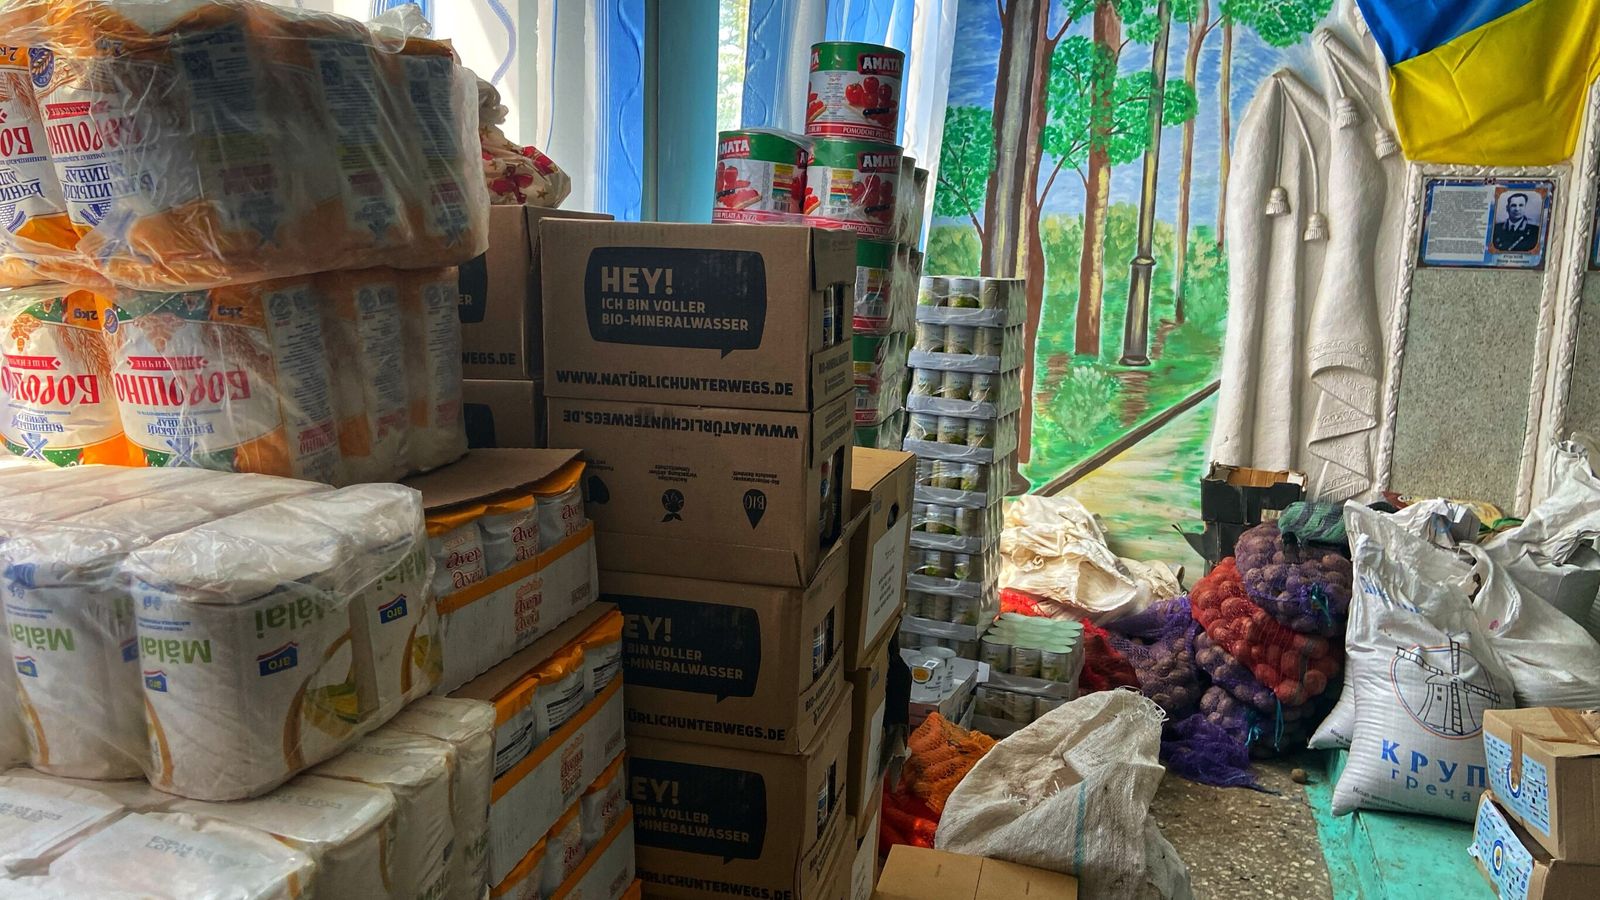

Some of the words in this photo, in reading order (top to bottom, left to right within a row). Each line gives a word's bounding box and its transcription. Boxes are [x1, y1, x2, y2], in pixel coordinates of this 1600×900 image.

[602, 266, 673, 295] HEY!
[602, 298, 624, 311] ICH
[627, 299, 650, 312] BIN
[654, 300, 706, 314] VOLLER
[602, 314, 749, 331] BIO-MINERALWASSER
[113, 369, 252, 407] БОРОШНО
[556, 370, 793, 396] WWW.NATÜRLICHUNTERWEGS.DE
[563, 409, 799, 440] WWW.NATÜRLICHUNTERWEGS.DE
[745, 495, 765, 510] BIO
[9, 622, 76, 652] Mălai
[625, 614, 672, 642] EY!
[139, 635, 213, 665] Mălai
[652, 645, 702, 661] VOLLER
[625, 706, 786, 742] ÜRLICHUNTERWEGS.DE
[1380, 738, 1487, 789] КРУП
[632, 776, 679, 805] EY!
[1390, 768, 1472, 803] греча
[661, 807, 709, 825] VOLLER
[636, 868, 793, 900] RLICHUNTERWEGS.DE
